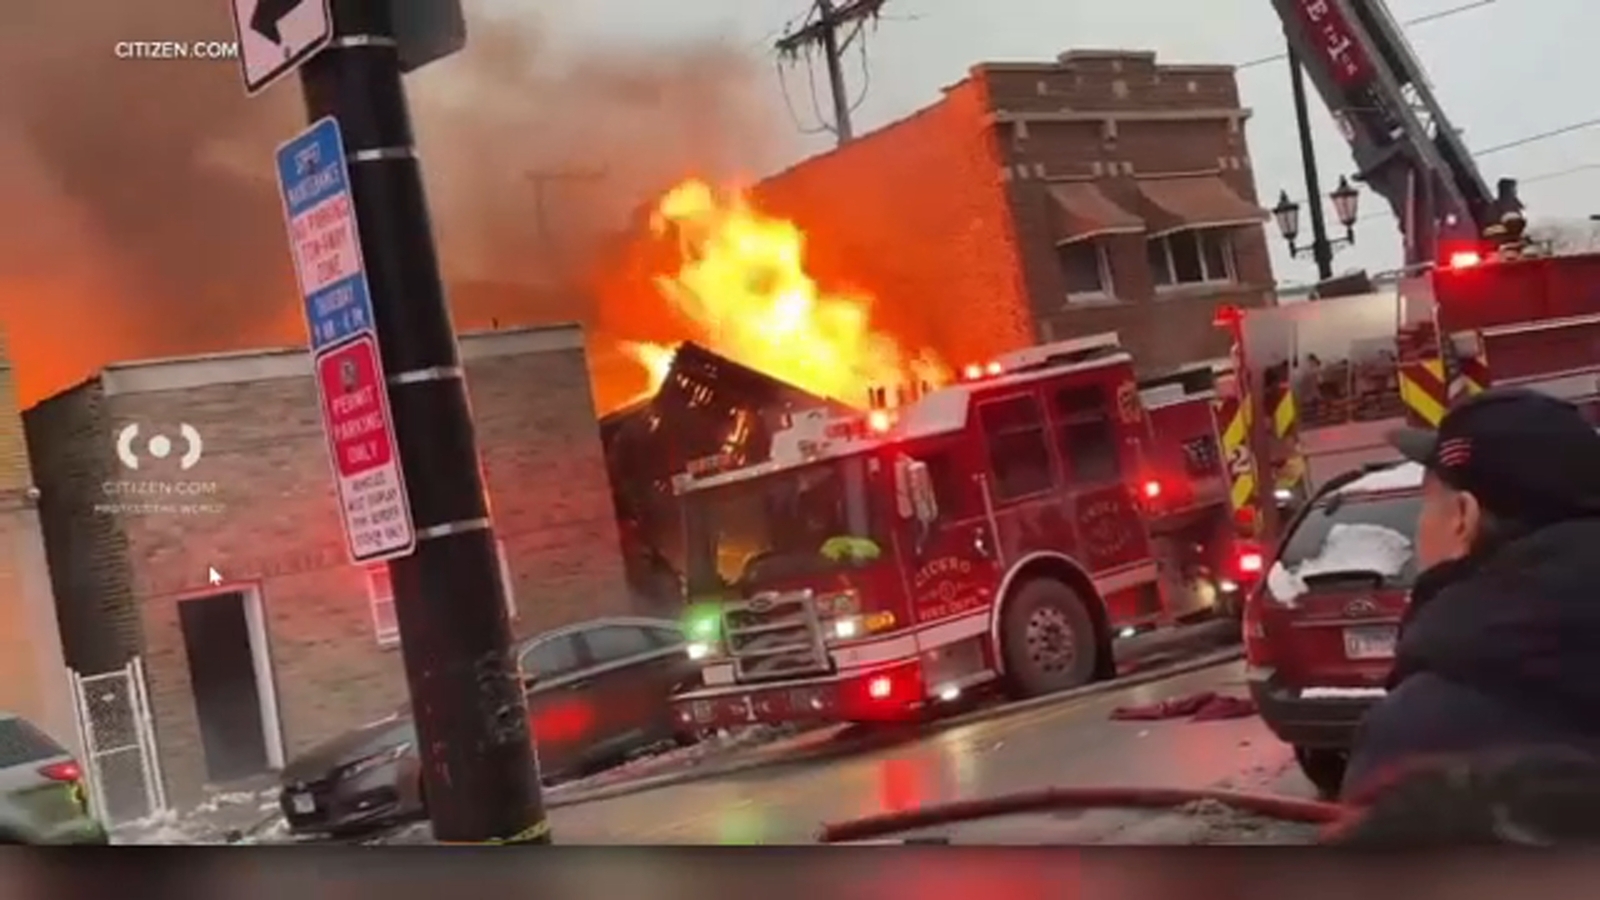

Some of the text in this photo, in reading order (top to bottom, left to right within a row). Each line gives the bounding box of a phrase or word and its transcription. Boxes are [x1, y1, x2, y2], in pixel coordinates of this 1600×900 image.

[1302, 0, 1329, 21] E
[333, 385, 375, 417] PERMIT
[334, 411, 384, 440] PARKING
[347, 442, 379, 464] ONLY
[1228, 445, 1252, 475] 2
[915, 556, 972, 588] CICERO
[920, 604, 946, 621] FIRE
